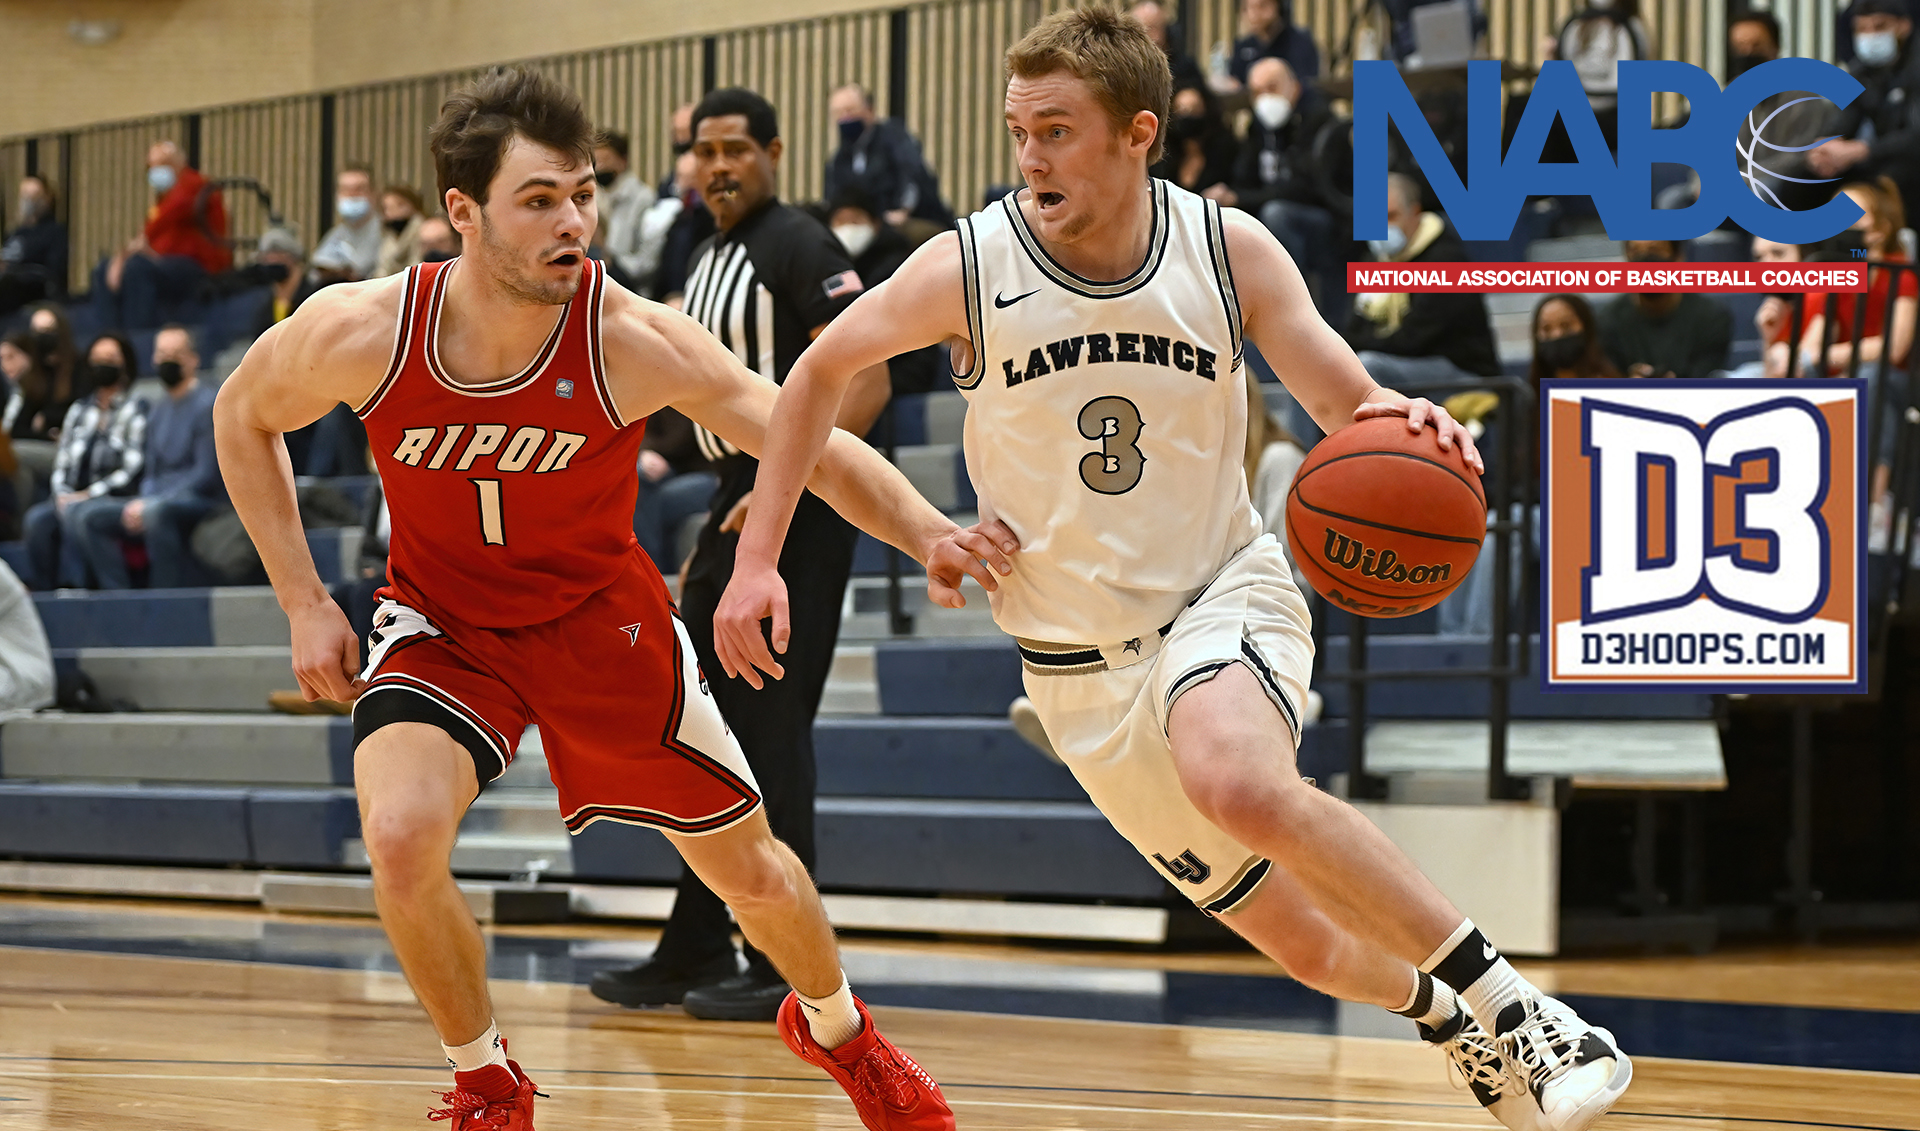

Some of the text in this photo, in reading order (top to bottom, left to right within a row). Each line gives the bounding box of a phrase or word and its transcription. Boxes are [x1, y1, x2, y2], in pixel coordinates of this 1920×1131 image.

[1002, 331, 1217, 388] LAWRENCE
[392, 423, 588, 474] RIPON
[1077, 394, 1148, 495] 3
[467, 478, 507, 546] 1
[1323, 527, 1452, 585] Wilson
